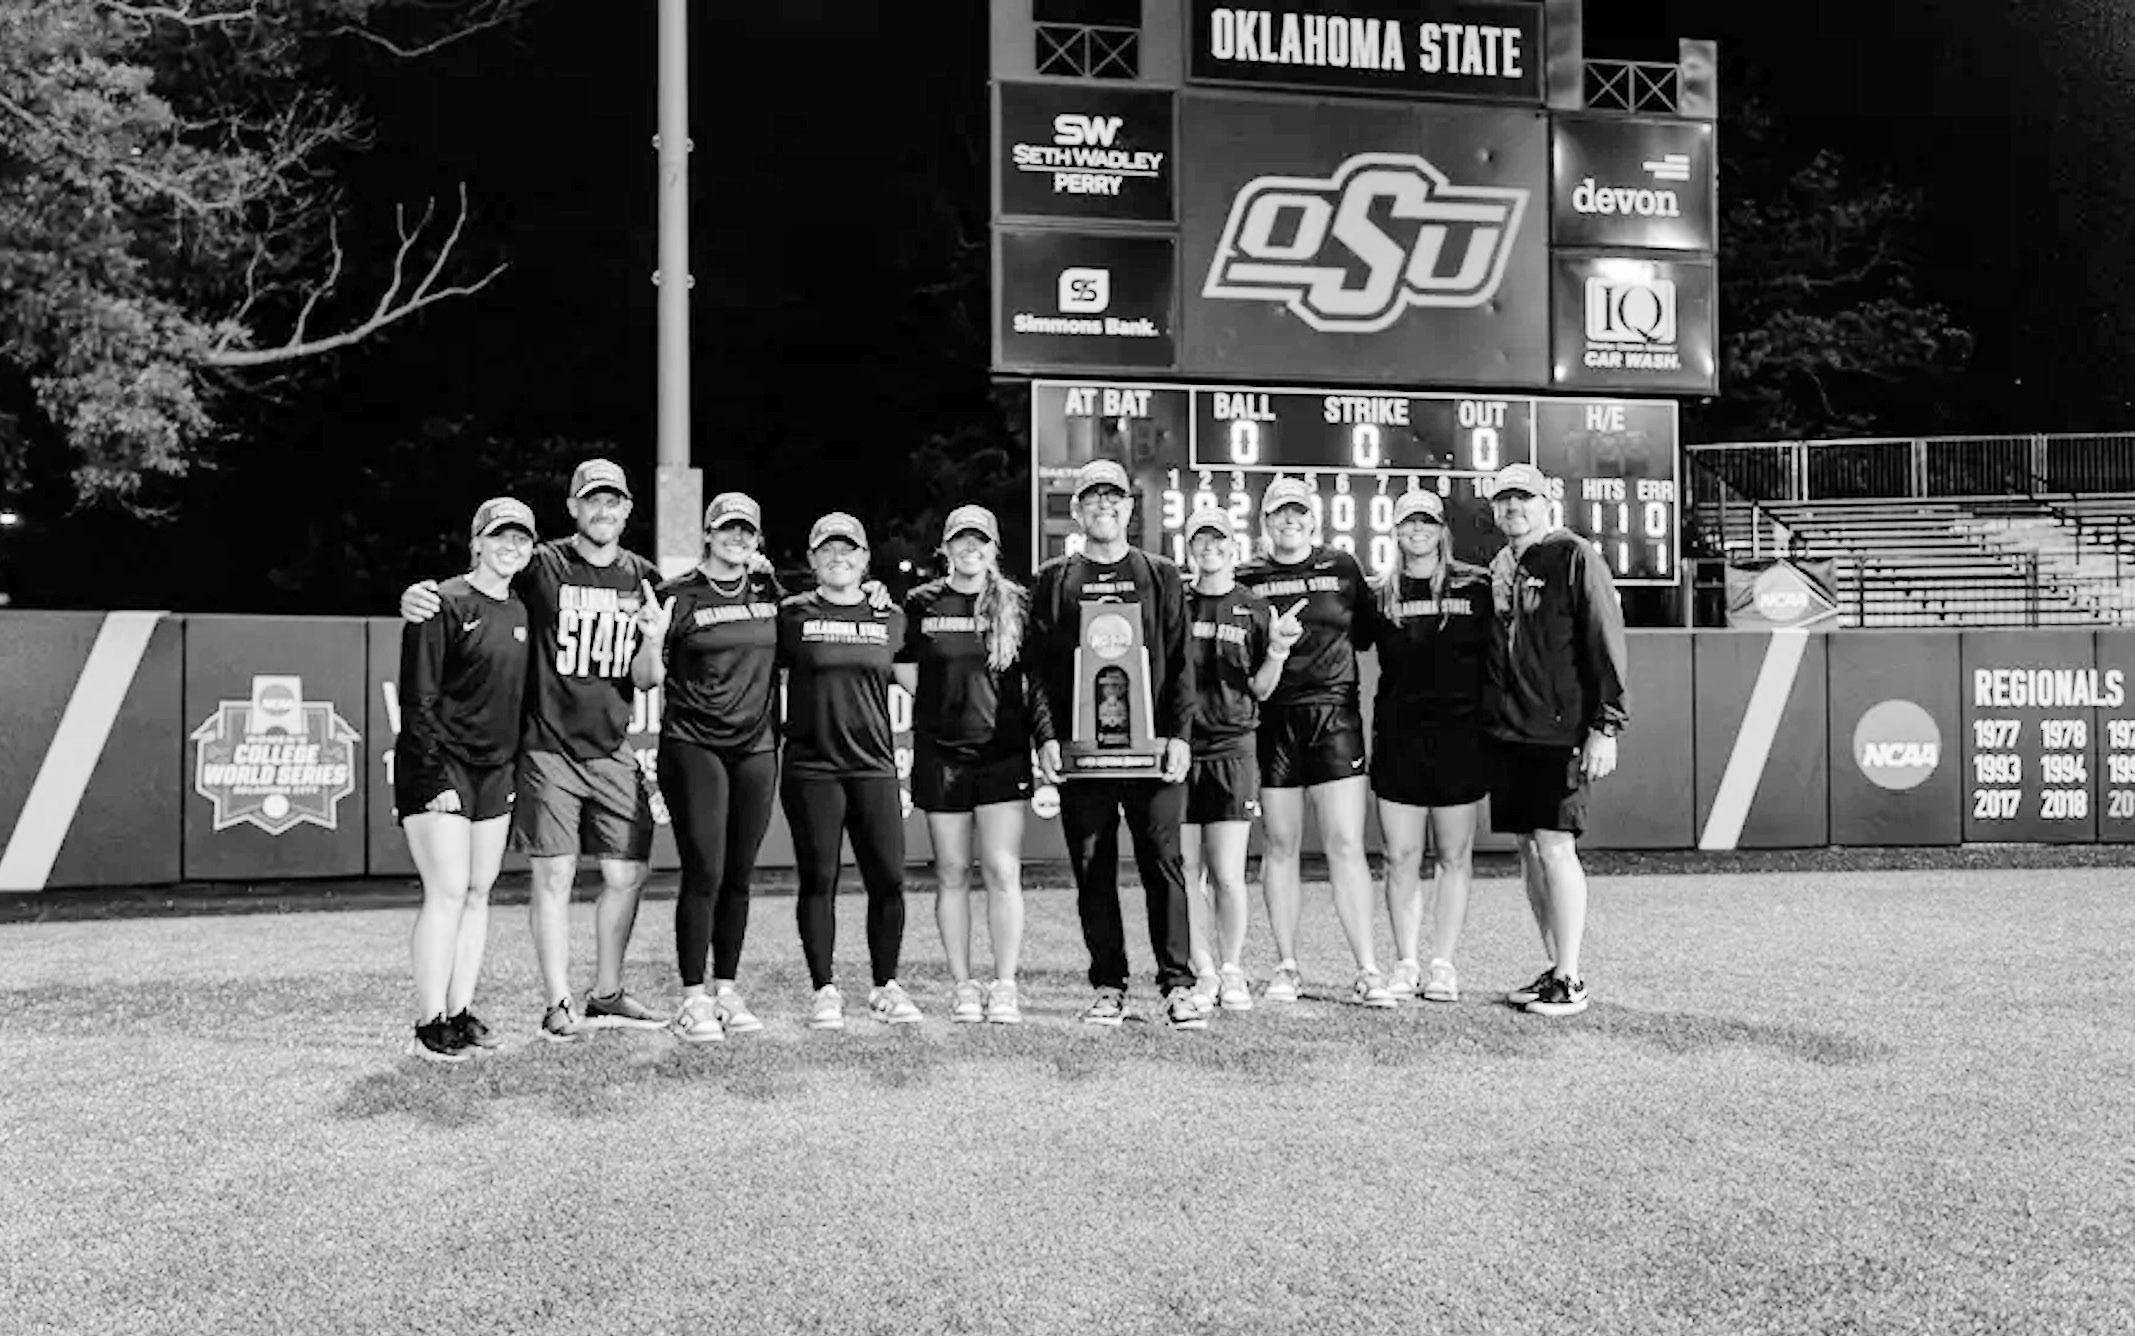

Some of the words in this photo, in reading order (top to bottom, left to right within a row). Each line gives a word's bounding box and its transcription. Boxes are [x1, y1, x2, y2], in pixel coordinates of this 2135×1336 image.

[1211, 8, 1405, 71] OKLAHOMA
[1419, 22, 1523, 78] STATE
[1053, 113, 1123, 147] SW
[1012, 143, 1072, 166] SETH
[1073, 147, 1164, 171] WADLEY
[1054, 172, 1123, 195] PERRY
[1572, 177, 1680, 217] devon
[1203, 152, 1531, 332] OSU
[1013, 313, 1103, 335] Simmons
[1600, 285, 1663, 343] IQ
[1584, 351, 1623, 368] CAR
[1064, 388, 1098, 417] AT
[1102, 389, 1152, 417] BAT
[1213, 392, 1276, 421] BALL
[1324, 396, 1411, 426] STRIKE
[1458, 400, 1509, 429] OUT
[1586, 405, 1626, 432] H/E
[1230, 420, 1260, 465] 0
[1352, 423, 1380, 469] 0
[1472, 427, 1499, 471] 0
[1168, 468, 1179, 490] 1
[1199, 471, 1213, 490] 2
[1231, 471, 1246, 491] 3
[1336, 474, 1351, 494] 6
[1377, 474, 1389, 495] 7
[1437, 475, 1451, 497] 9
[1582, 478, 1626, 501] HITS
[1637, 480, 1674, 501] ERR
[1162, 490, 1185, 528] 3
[1228, 492, 1251, 529] 2
[1331, 494, 1355, 531] 0
[1369, 495, 1395, 532] 0
[1645, 502, 1668, 538] 0
[1759, 591, 1809, 609] NCAA
[1974, 668, 2125, 707] REGIONALS
[1973, 719, 2022, 749] 1977
[2040, 719, 2087, 750] 1978
[233, 744, 321, 765] COLLEGE
[1862, 742, 1939, 768] NCAA
[1973, 753, 2022, 784] 1993
[2040, 754, 2088, 784] 1994
[203, 764, 276, 786] WORLD
[275, 764, 348, 786] SERIES
[1973, 789, 2022, 819] 2017
[2040, 789, 2089, 819] 2018
